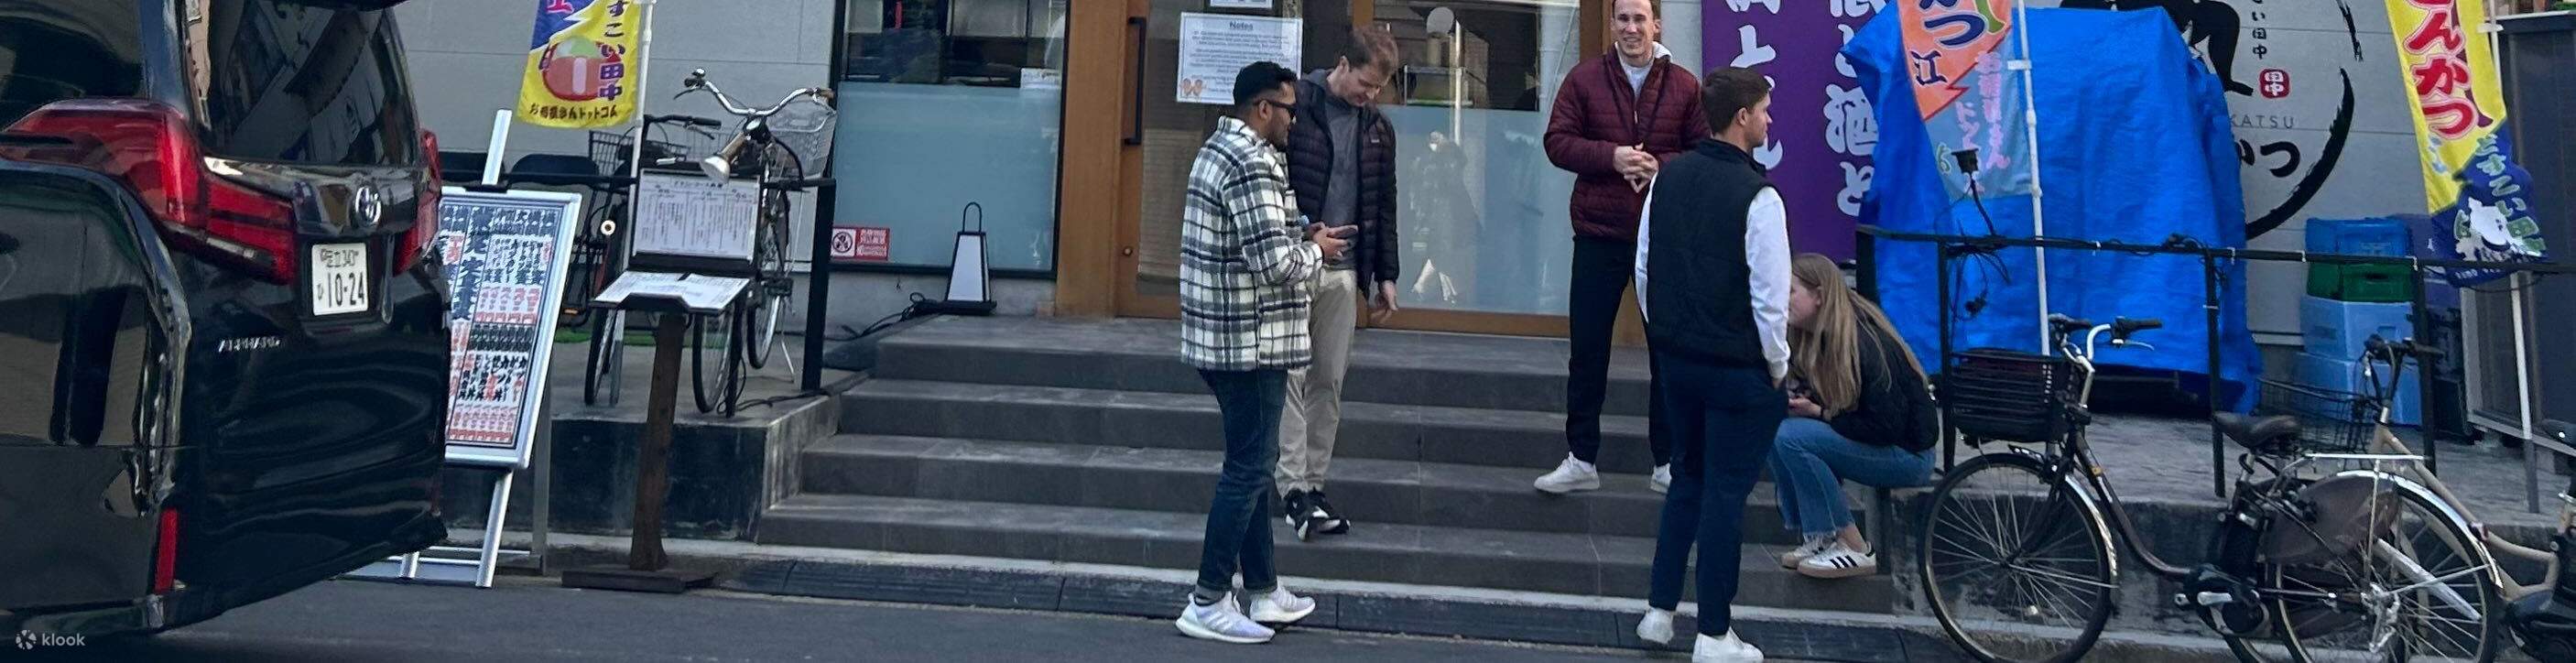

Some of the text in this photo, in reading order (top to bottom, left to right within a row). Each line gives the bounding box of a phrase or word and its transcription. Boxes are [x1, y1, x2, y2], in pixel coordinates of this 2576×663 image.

[2251, 0, 2268, 60] い田中
[2406, 0, 2475, 137] んかつ
